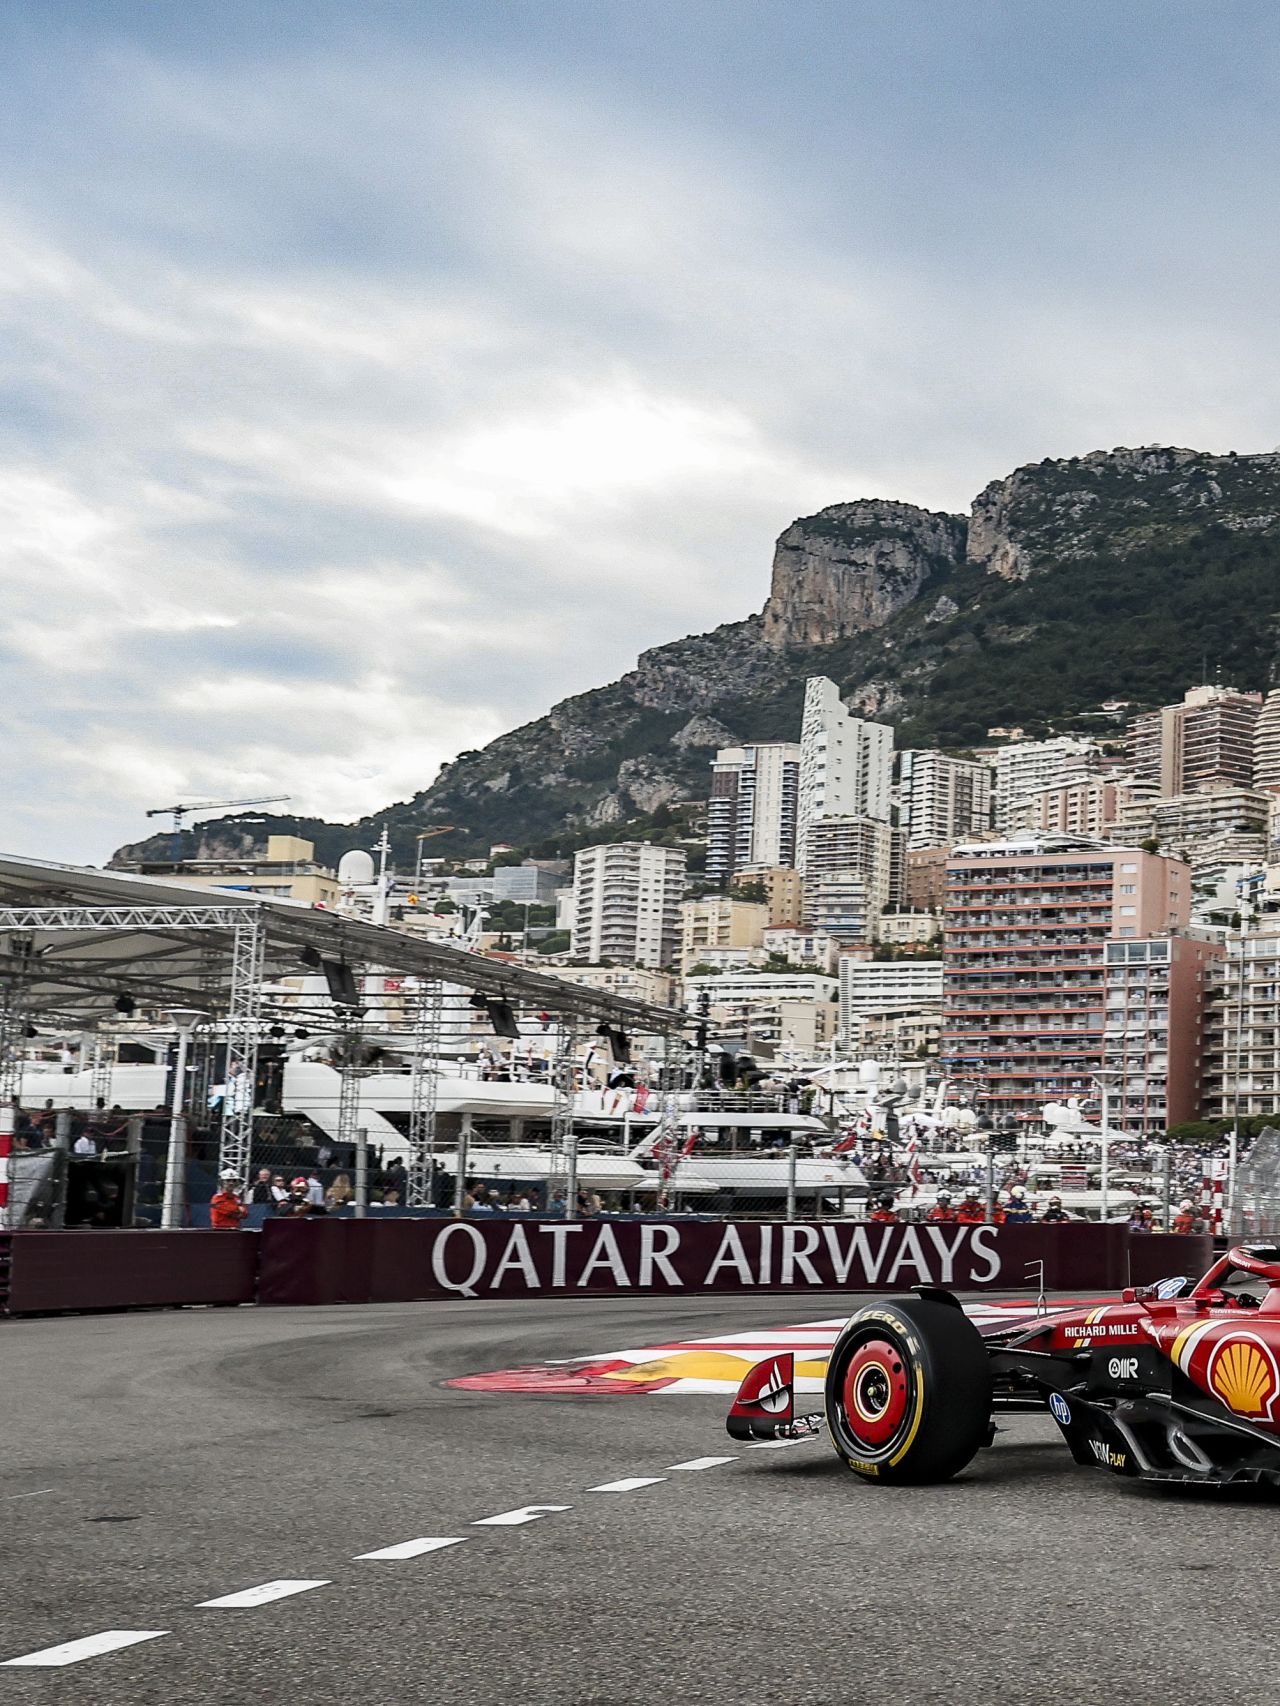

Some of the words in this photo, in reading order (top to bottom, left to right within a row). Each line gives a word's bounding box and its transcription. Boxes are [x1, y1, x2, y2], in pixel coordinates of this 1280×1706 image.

[431, 1223, 684, 1297] QATAR
[703, 1224, 1002, 1285] AIRWAYS
[1064, 1325, 1106, 1338] RICHARD
[1108, 1324, 1138, 1335] MILLE
[1051, 1393, 1069, 1424] hp
[1110, 1452, 1127, 1468] PLAY
